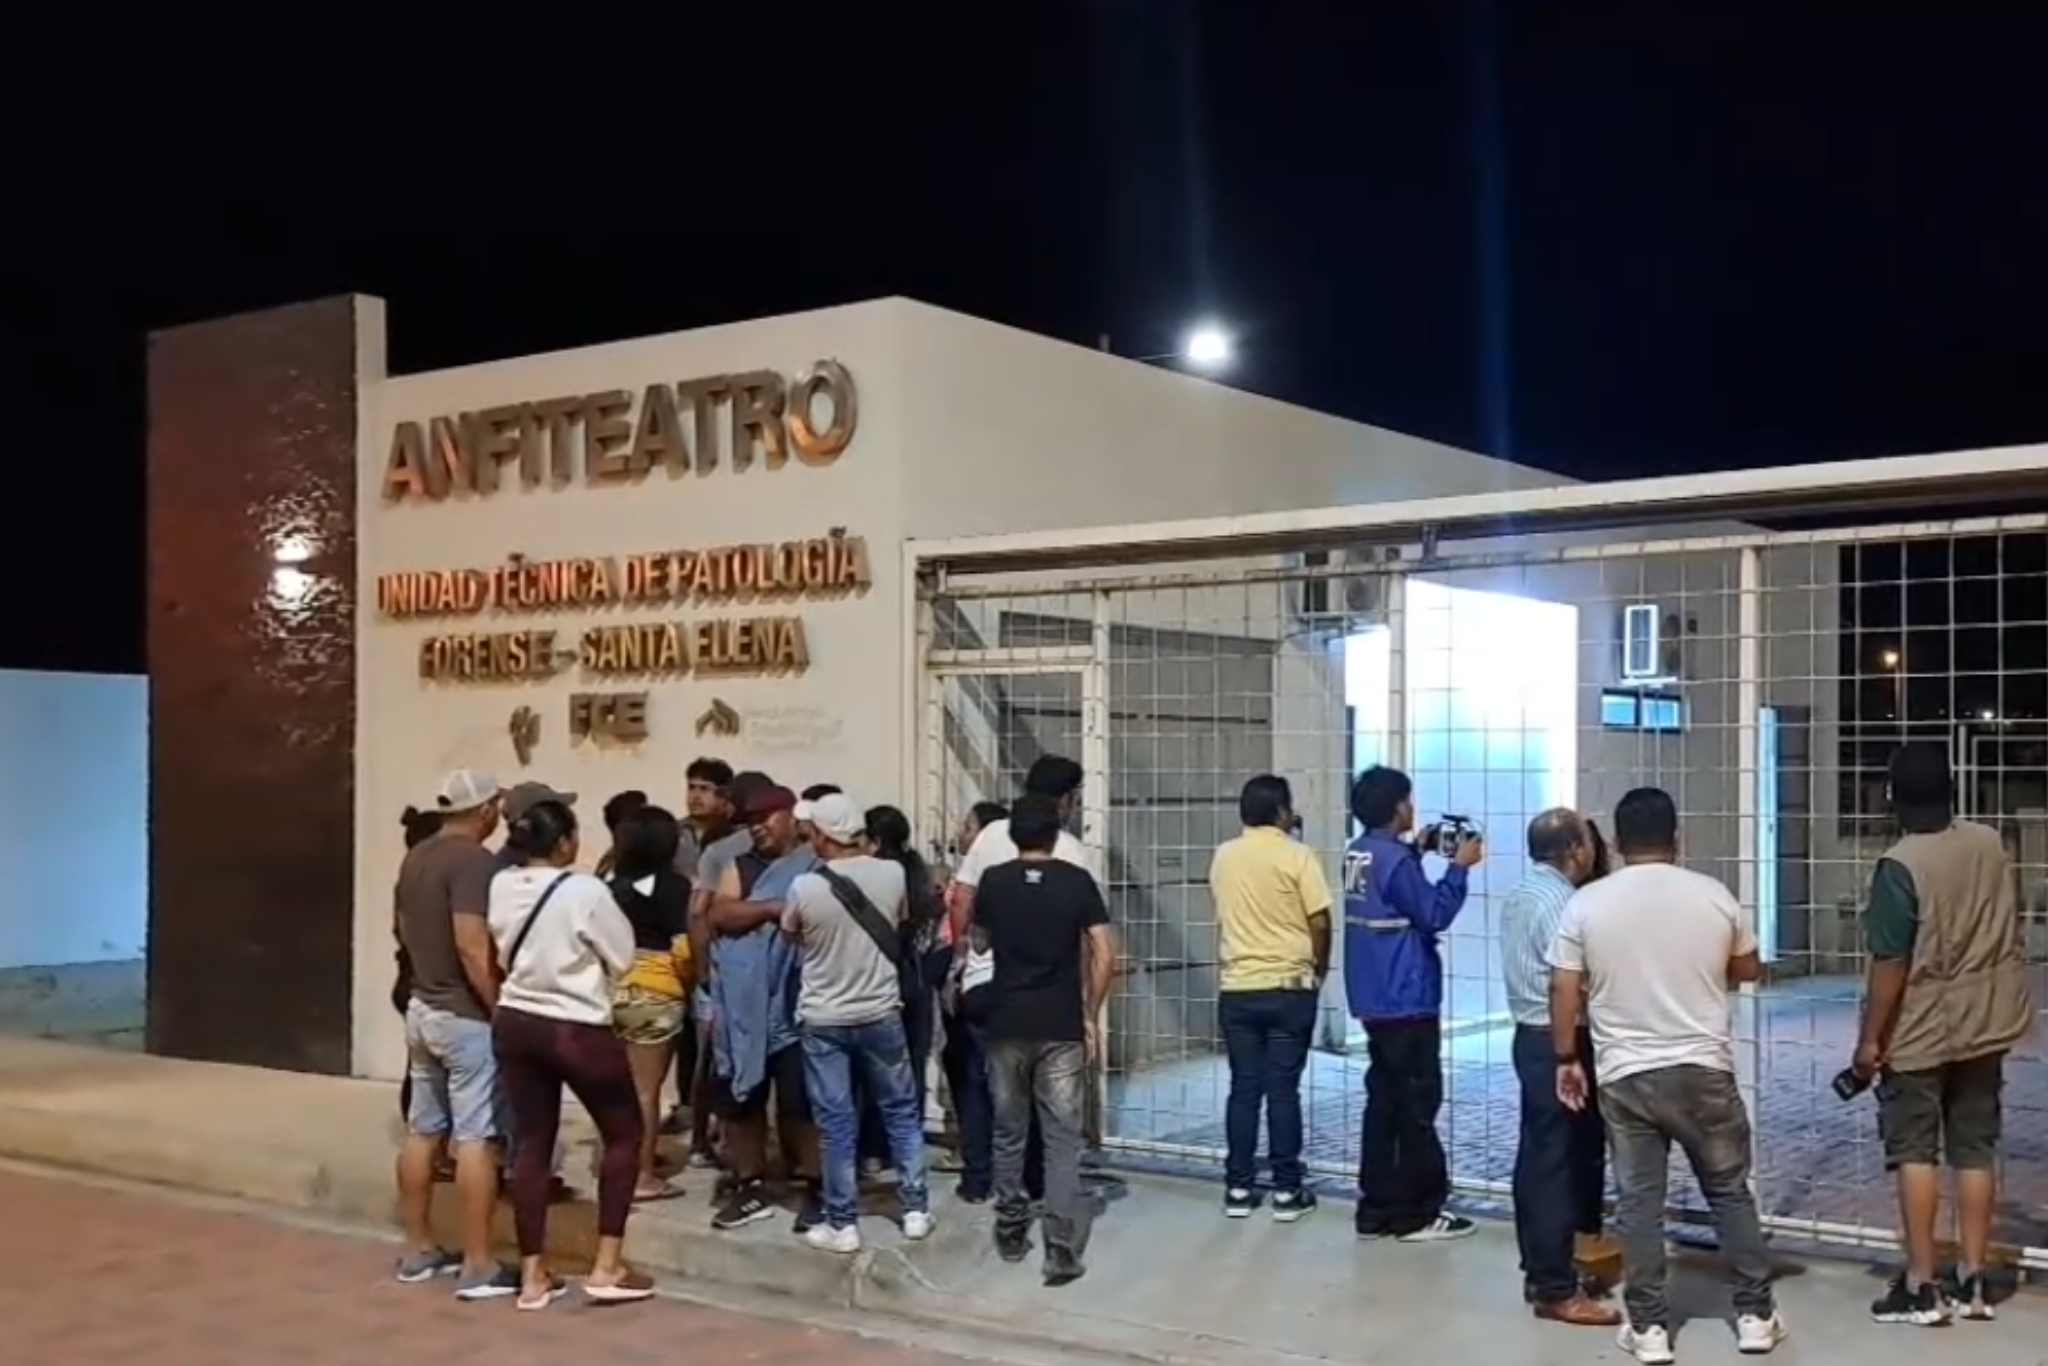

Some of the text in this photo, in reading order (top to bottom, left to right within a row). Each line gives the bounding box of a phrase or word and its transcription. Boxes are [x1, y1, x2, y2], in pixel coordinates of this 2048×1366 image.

[383, 359, 857, 504] ANFITEATRO
[377, 526, 871, 616] UNIDAD TÉCNICA DE PATOLOGÍA
[419, 629, 557, 686] FORENSE
[581, 621, 691, 679] SANTA
[693, 614, 810, 676] ELENA
